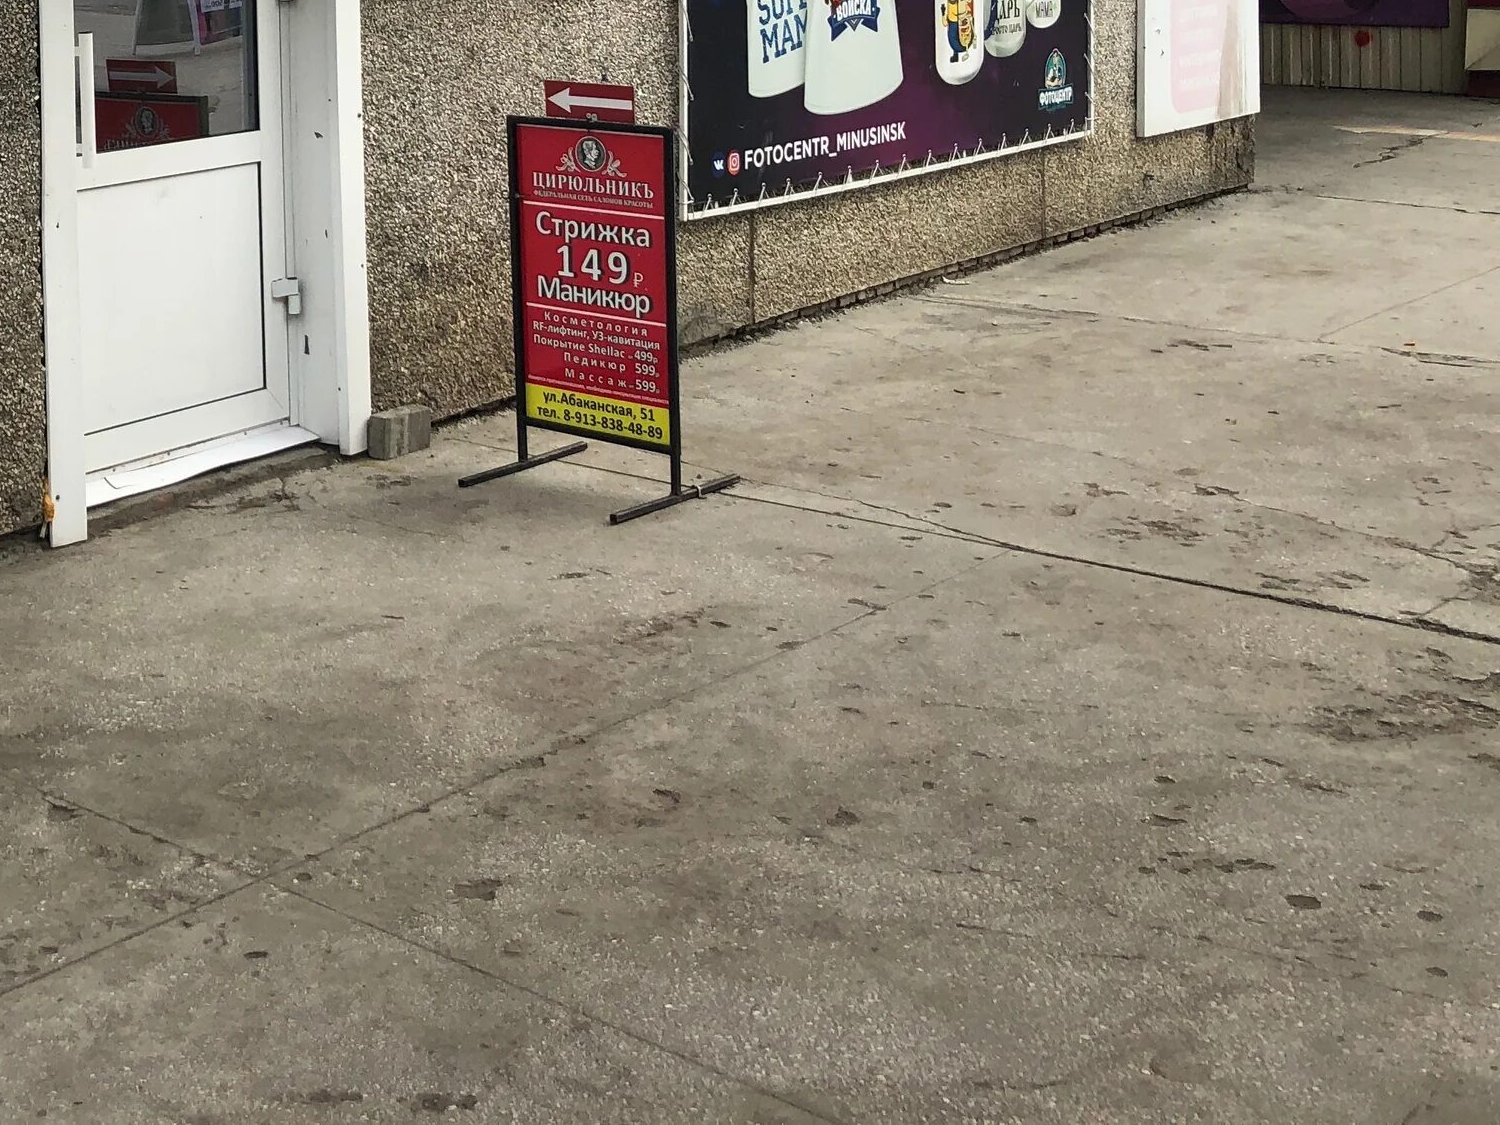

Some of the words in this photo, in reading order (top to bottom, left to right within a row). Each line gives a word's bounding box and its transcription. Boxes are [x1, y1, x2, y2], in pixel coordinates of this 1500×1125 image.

[1039, 86, 1073, 106] ФОТОЦЕНТР
[744, 121, 907, 170] FOTOCENTR_MINUSINSK
[533, 172, 654, 199] ЦИРЮЛЬНИКЪ
[536, 211, 650, 248] Стрижка
[537, 275, 650, 318] Маникюр
[544, 311, 648, 337] Косметология
[533, 333, 585, 352] Покрытие
[588, 342, 625, 359] Shellac
[564, 352, 626, 373] Педикюр
[564, 368, 627, 388] Массаж
[537, 407, 560, 419] тел.
[563, 408, 663, 439] 8-913-838-48-89
[640, 408, 655, 421] 51
